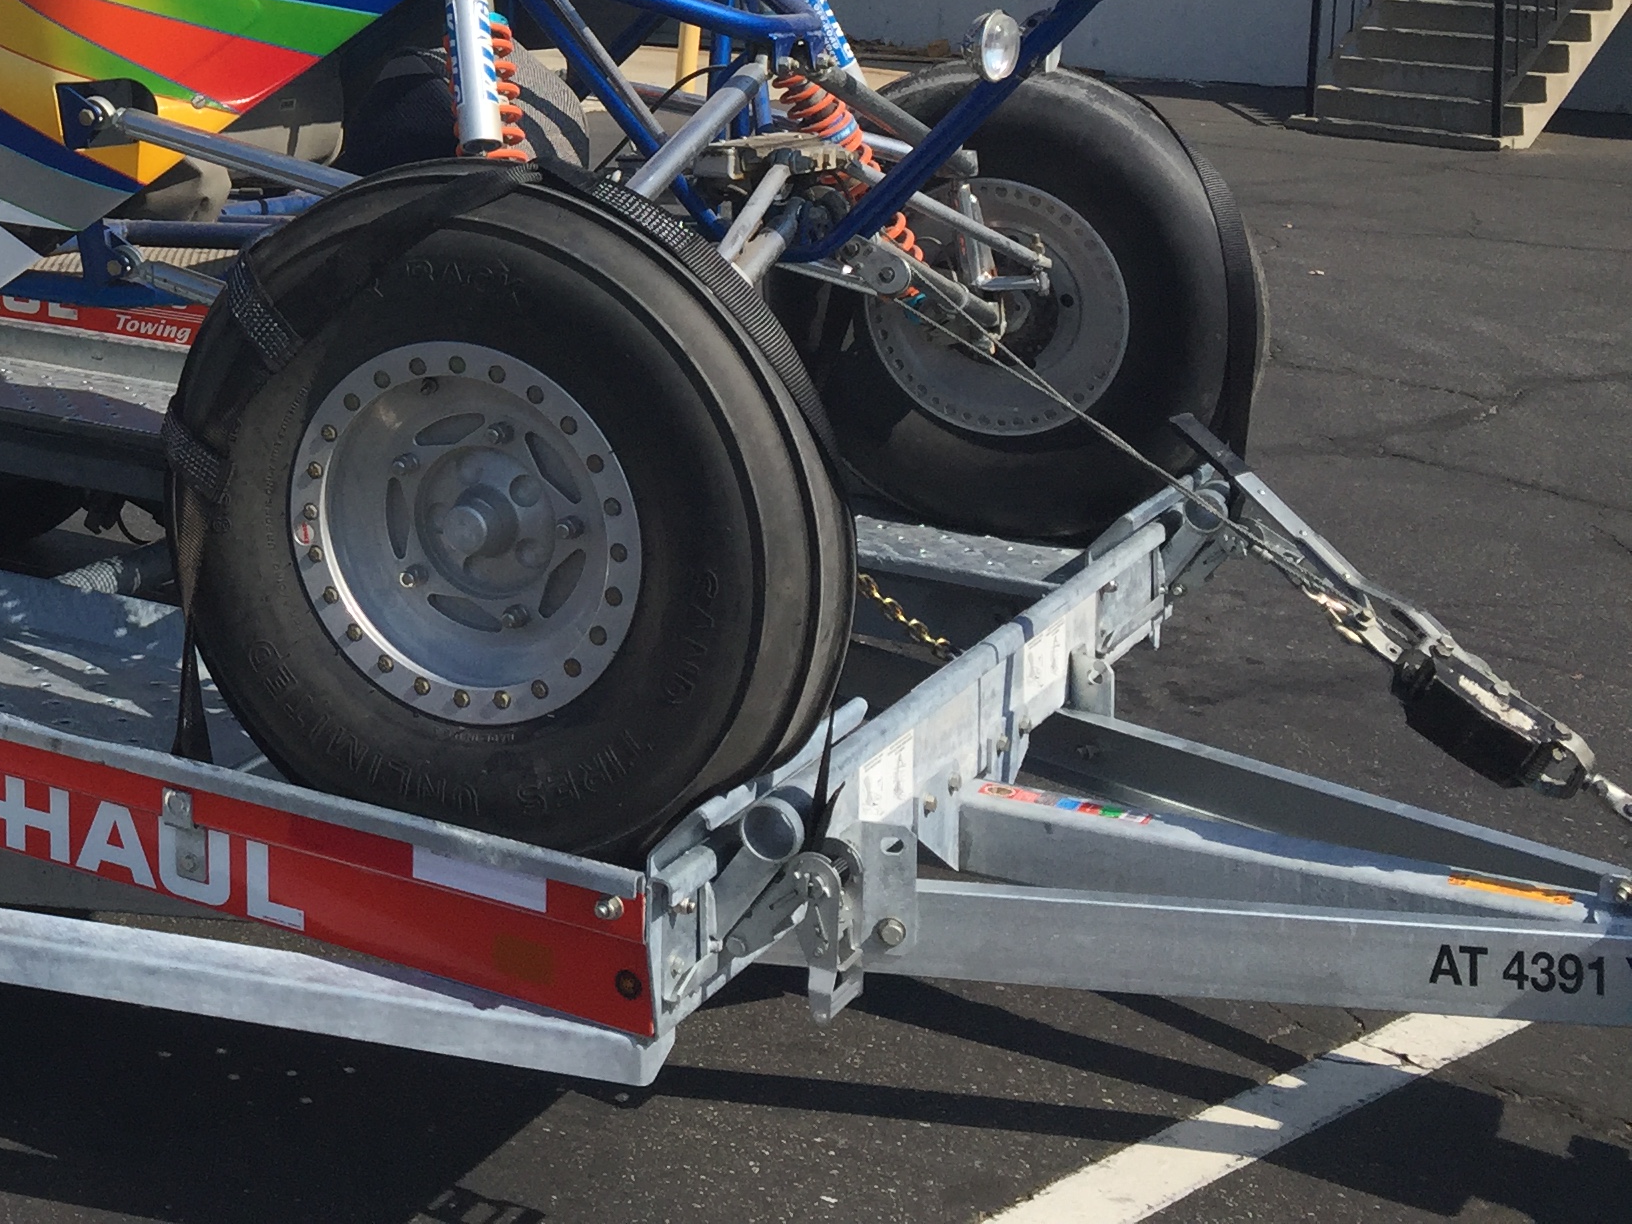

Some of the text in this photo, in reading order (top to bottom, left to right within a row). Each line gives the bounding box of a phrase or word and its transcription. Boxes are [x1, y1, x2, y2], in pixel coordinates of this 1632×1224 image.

[115, 313, 192, 344] Towing
[1429, 944, 1605, 996] AT 4391
